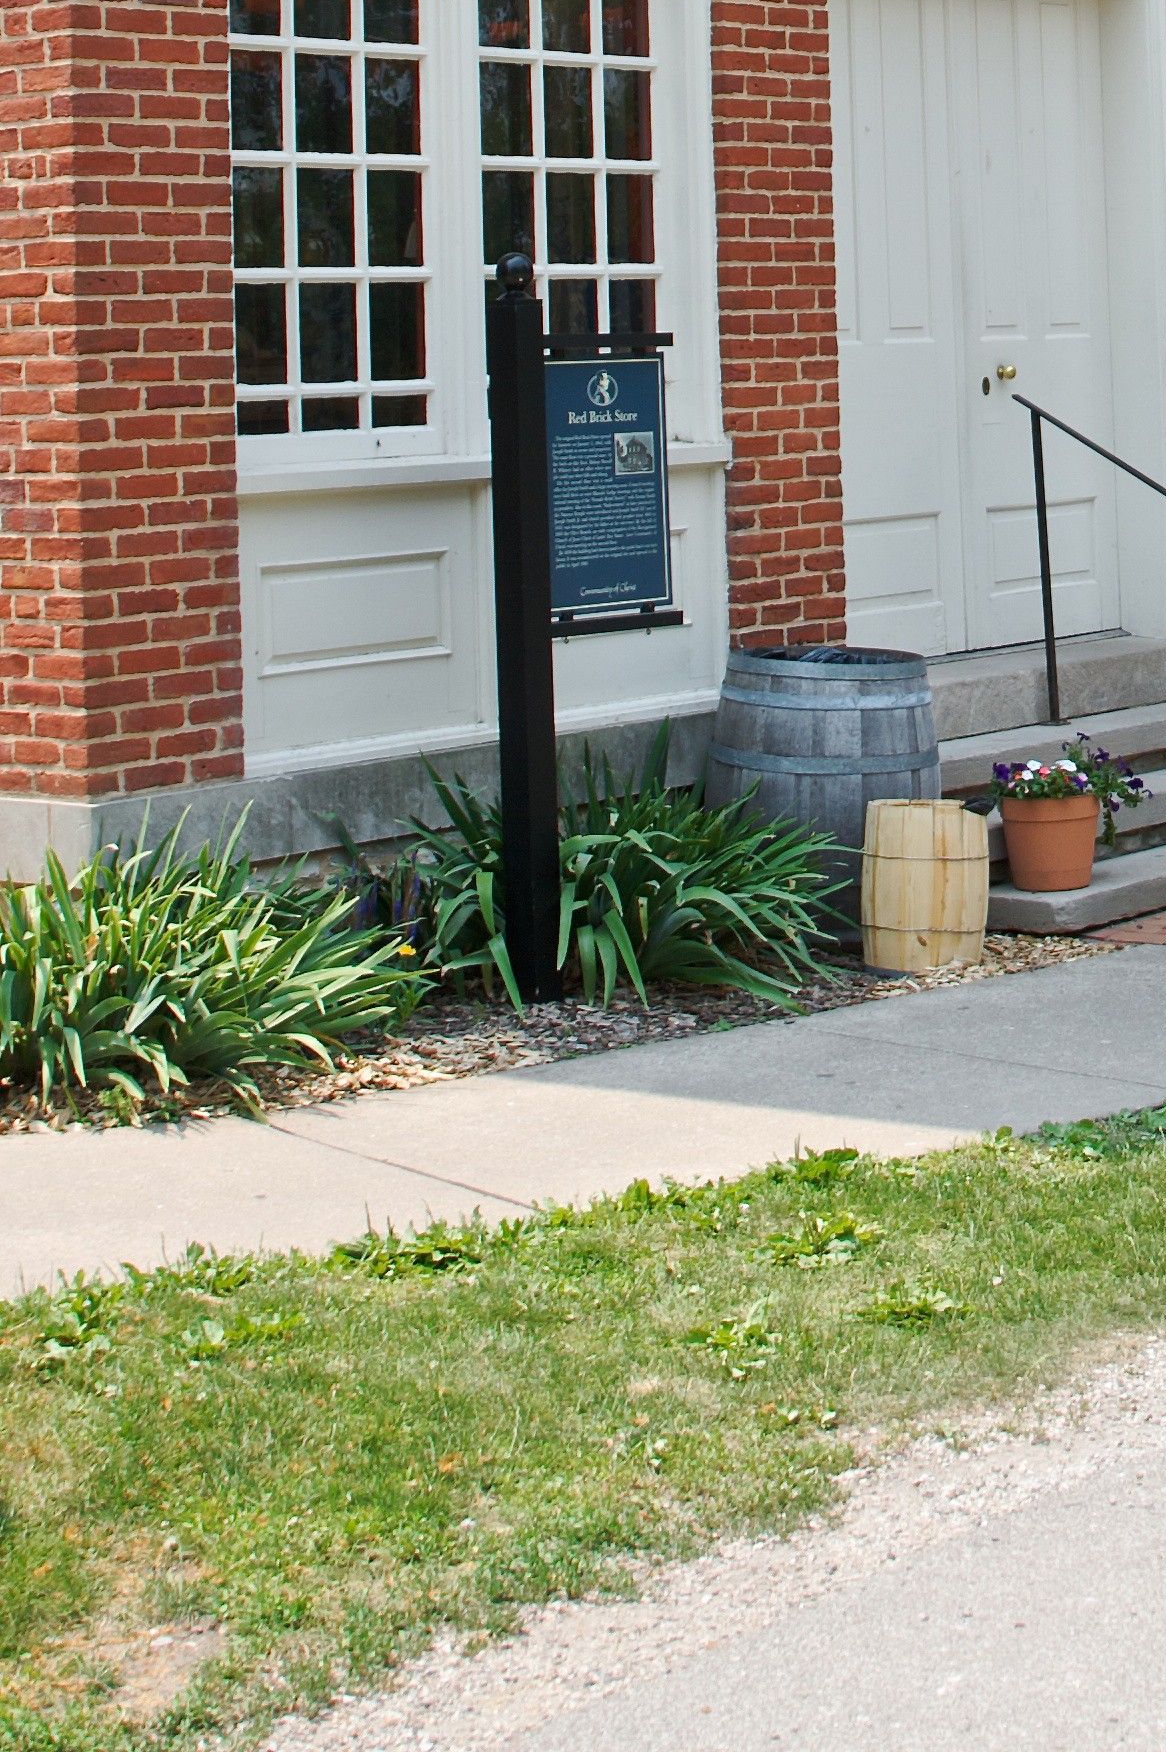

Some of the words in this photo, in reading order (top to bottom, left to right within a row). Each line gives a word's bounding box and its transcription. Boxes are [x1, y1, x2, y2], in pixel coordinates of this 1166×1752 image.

[567, 410, 587, 424] Red
[588, 409, 613, 423] Brick
[614, 409, 638, 422] Store
